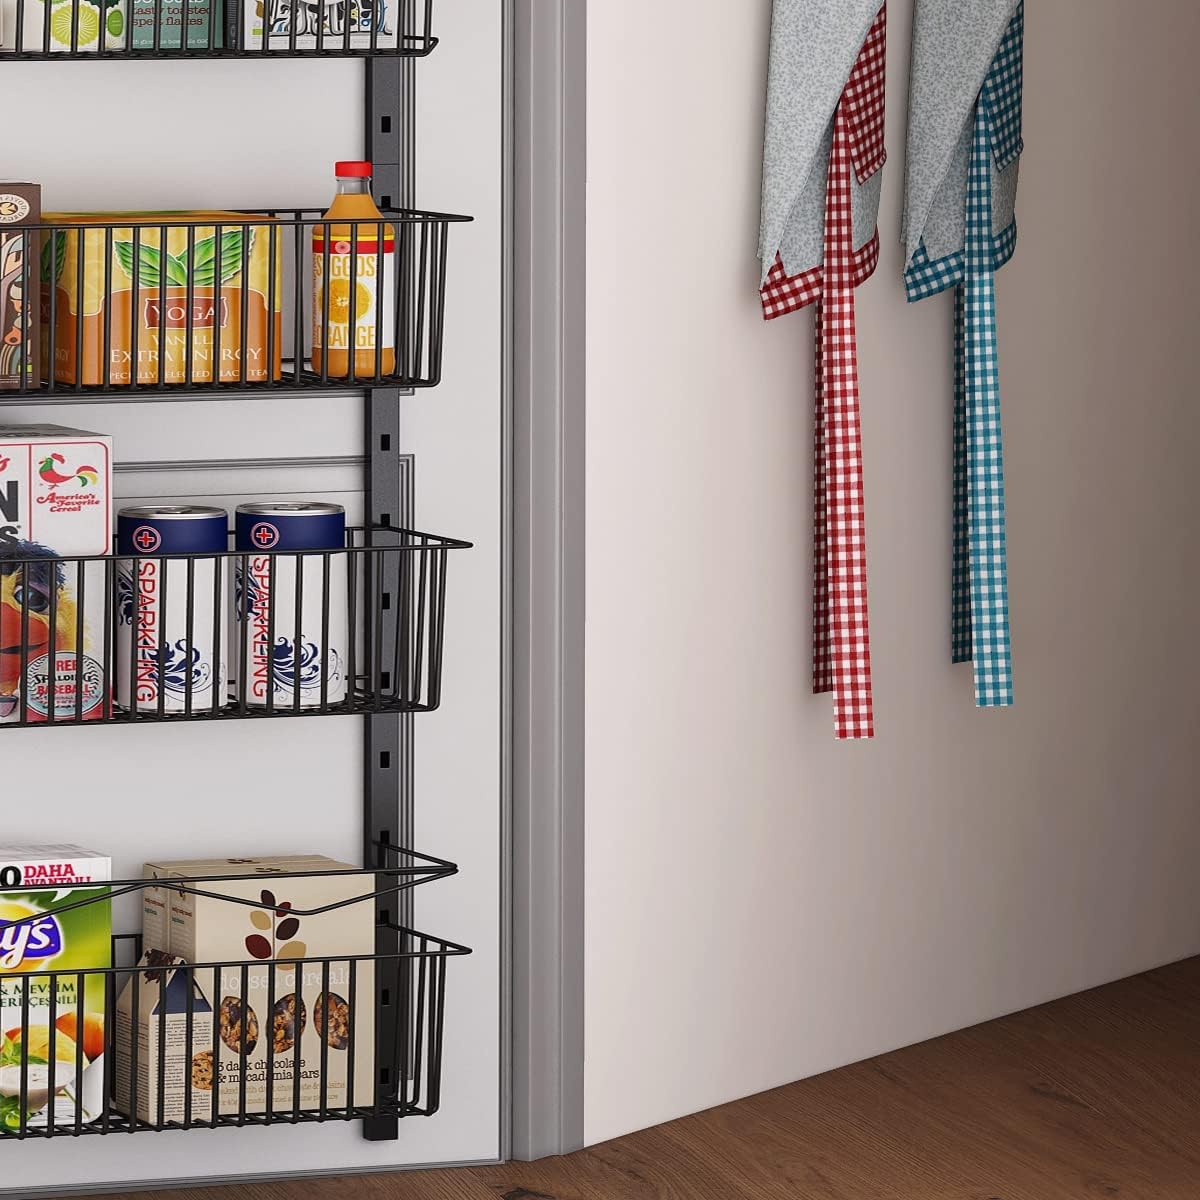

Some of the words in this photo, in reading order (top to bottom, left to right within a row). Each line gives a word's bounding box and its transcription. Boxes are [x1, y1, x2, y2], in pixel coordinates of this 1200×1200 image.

[36, 492, 96, 504] America's
[56, 498, 101, 507] Favorite
[49, 505, 82, 513] Cereal
[23, 863, 76, 879] DAHA
